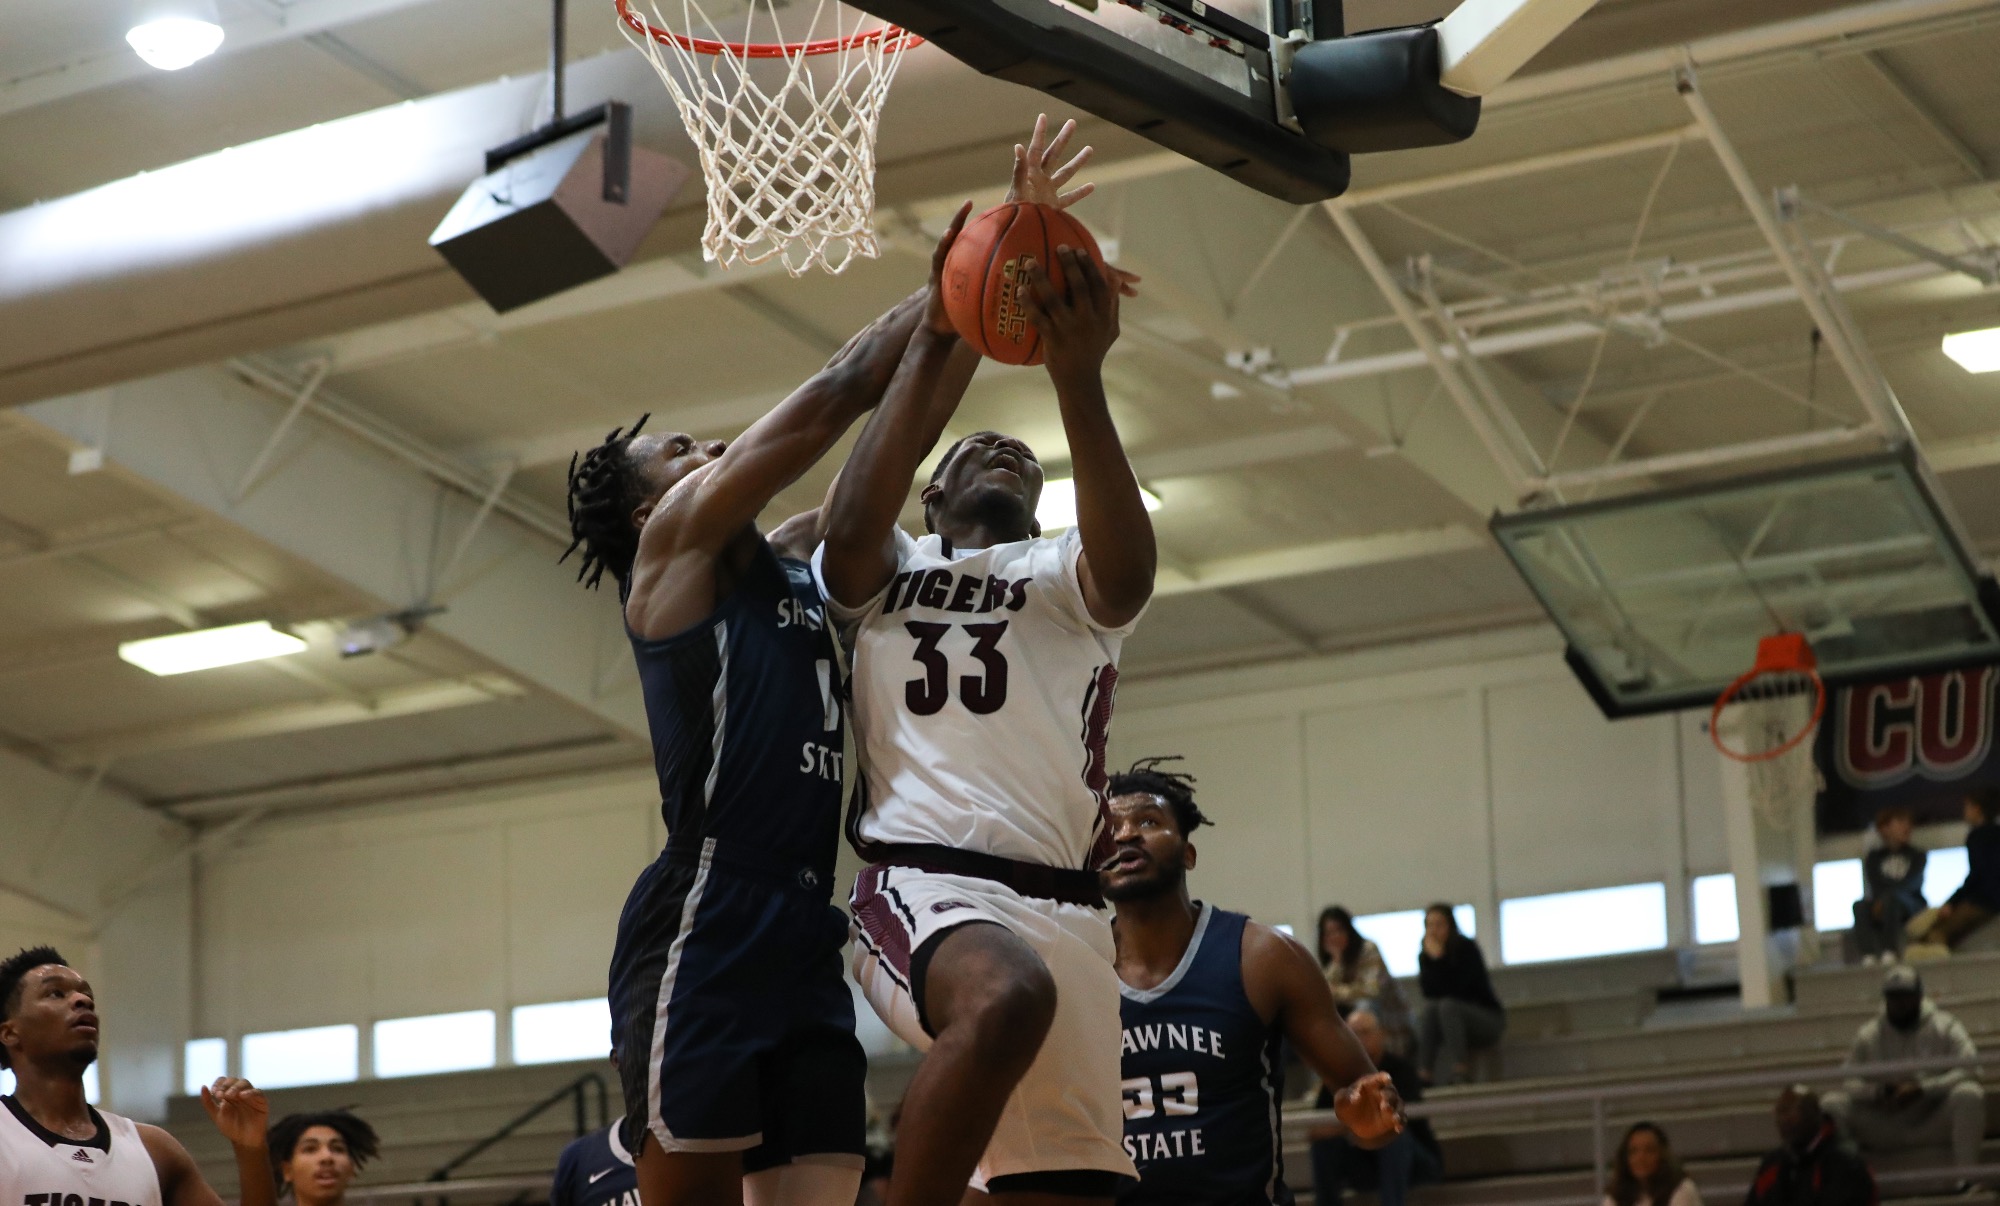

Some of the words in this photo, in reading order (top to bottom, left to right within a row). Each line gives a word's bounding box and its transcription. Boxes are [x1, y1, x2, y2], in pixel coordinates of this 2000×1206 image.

[882, 569, 1033, 615] TIGERS
[904, 620, 1009, 716] 33
[1836, 667, 1996, 788] CU
[1123, 1129, 1205, 1162] STATE
